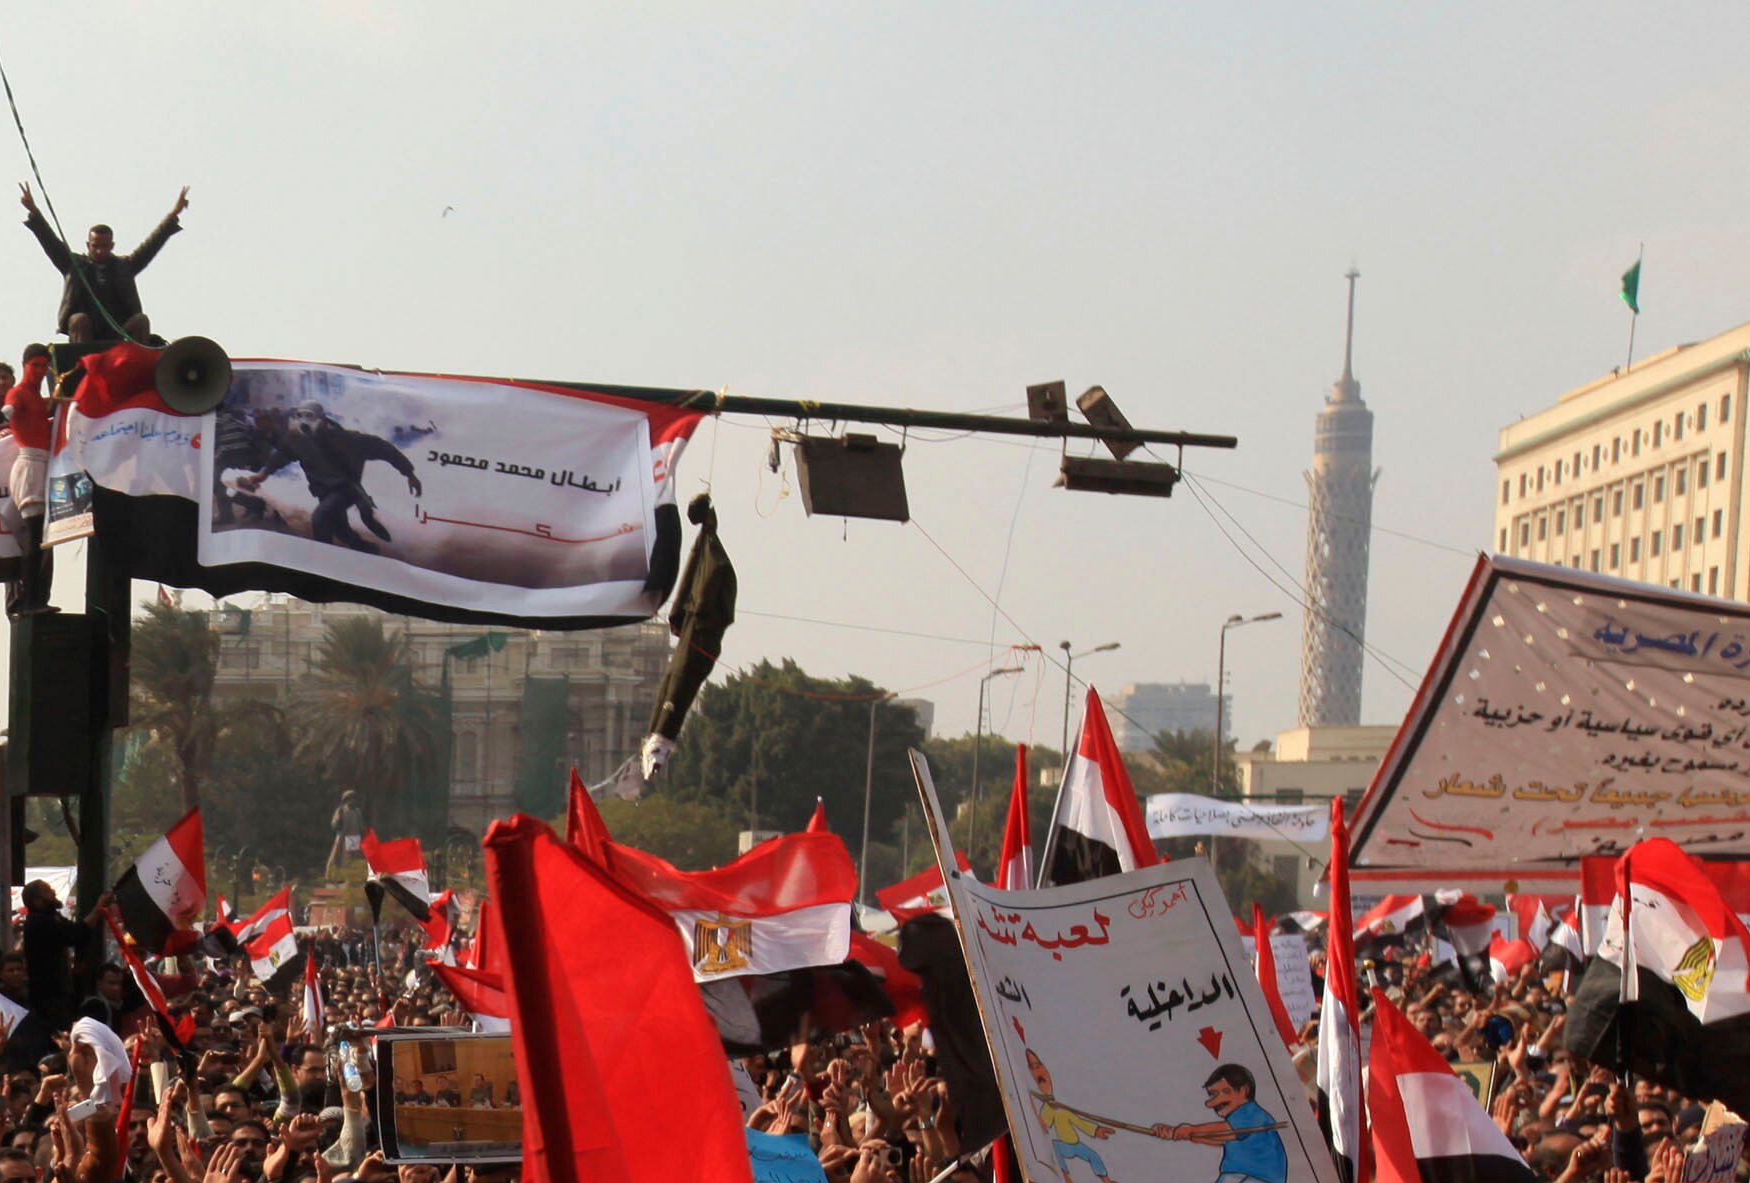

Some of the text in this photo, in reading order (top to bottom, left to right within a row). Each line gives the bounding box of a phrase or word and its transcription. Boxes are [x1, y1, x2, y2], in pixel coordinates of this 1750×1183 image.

[427, 449, 621, 497] أبطال محمد محمود
[415, 503, 644, 544] شكرا
[1594, 615, 1719, 654] المصرية
[1471, 697, 1543, 729] حزبية
[1576, 710, 1659, 740] سياسية
[1423, 772, 1507, 800] شعار
[1120, 972, 1235, 1032] الداخلية
